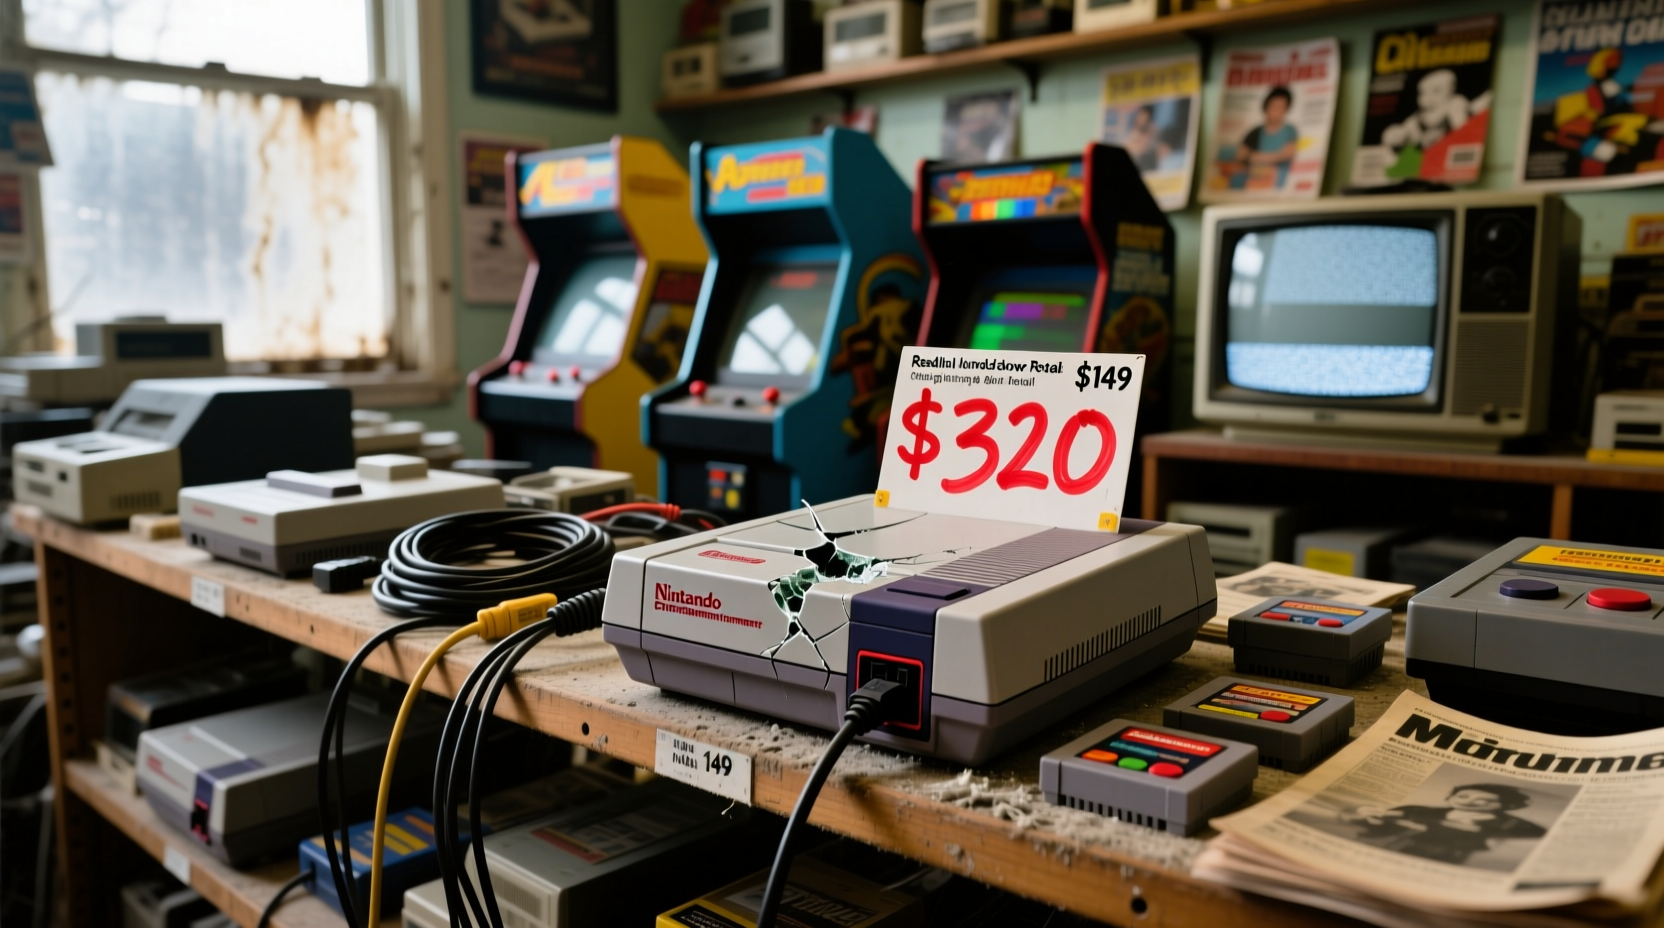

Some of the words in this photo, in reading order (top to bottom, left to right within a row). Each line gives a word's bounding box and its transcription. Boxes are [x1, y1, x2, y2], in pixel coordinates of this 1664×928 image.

[1075, 361, 1133, 392] $149
[897, 387, 1117, 496] $320
[654, 582, 722, 610] Nintando
[703, 750, 733, 777] 149
